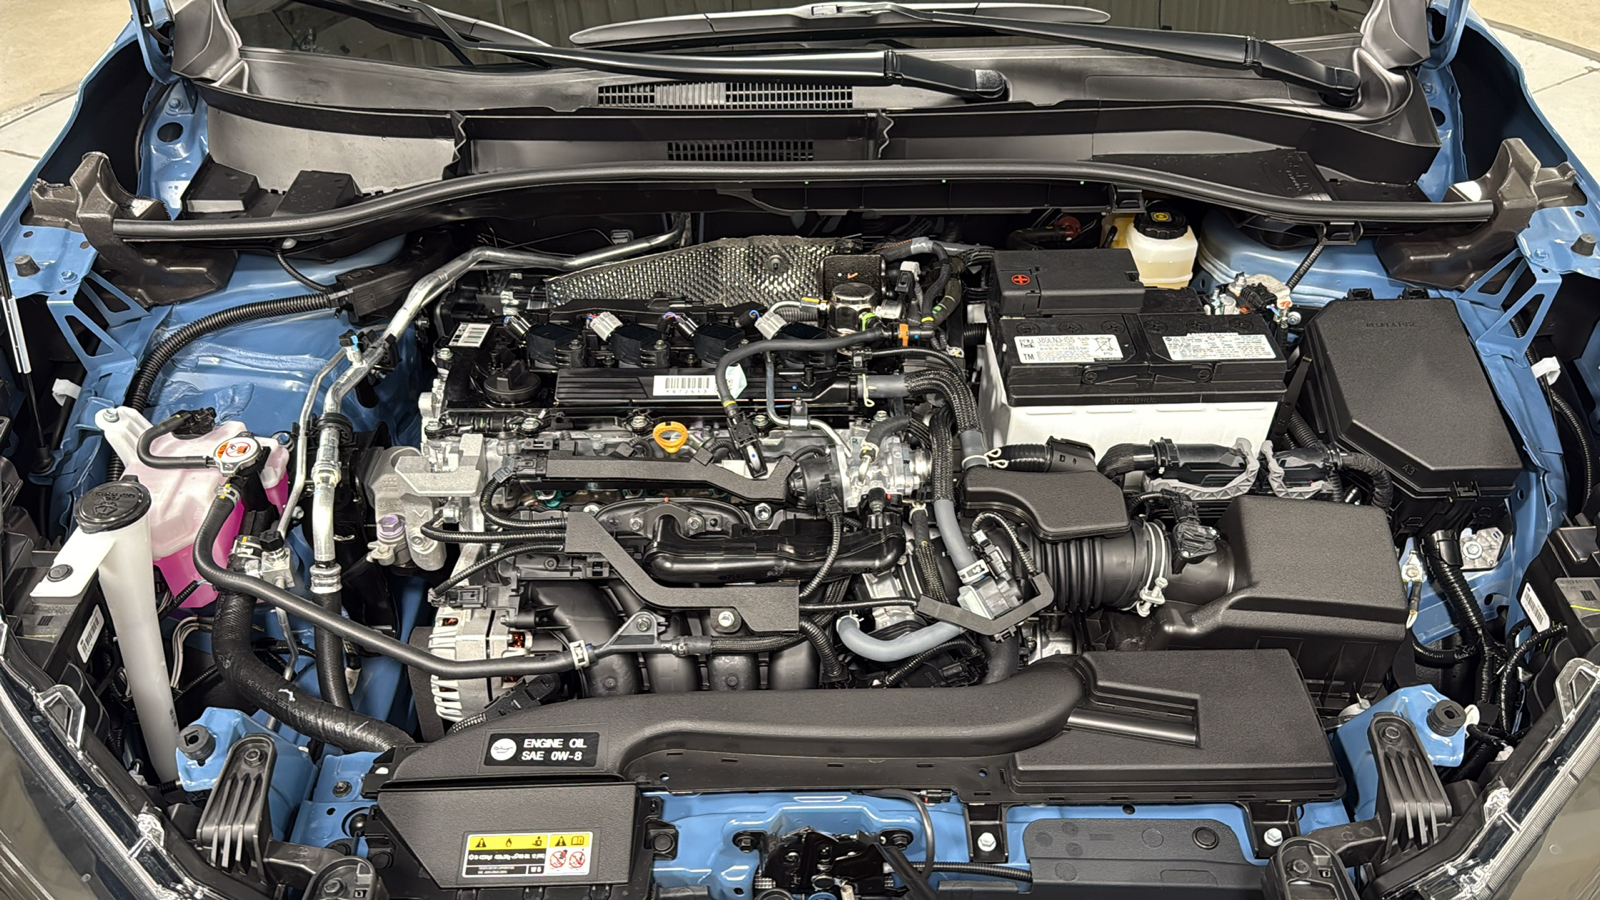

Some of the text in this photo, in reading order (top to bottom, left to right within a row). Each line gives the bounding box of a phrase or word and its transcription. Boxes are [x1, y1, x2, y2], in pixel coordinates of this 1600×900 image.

[1023, 353, 1035, 361] TM
[523, 738, 588, 748] ENGINE OIL
[521, 751, 583, 761] SAE 0W-8
